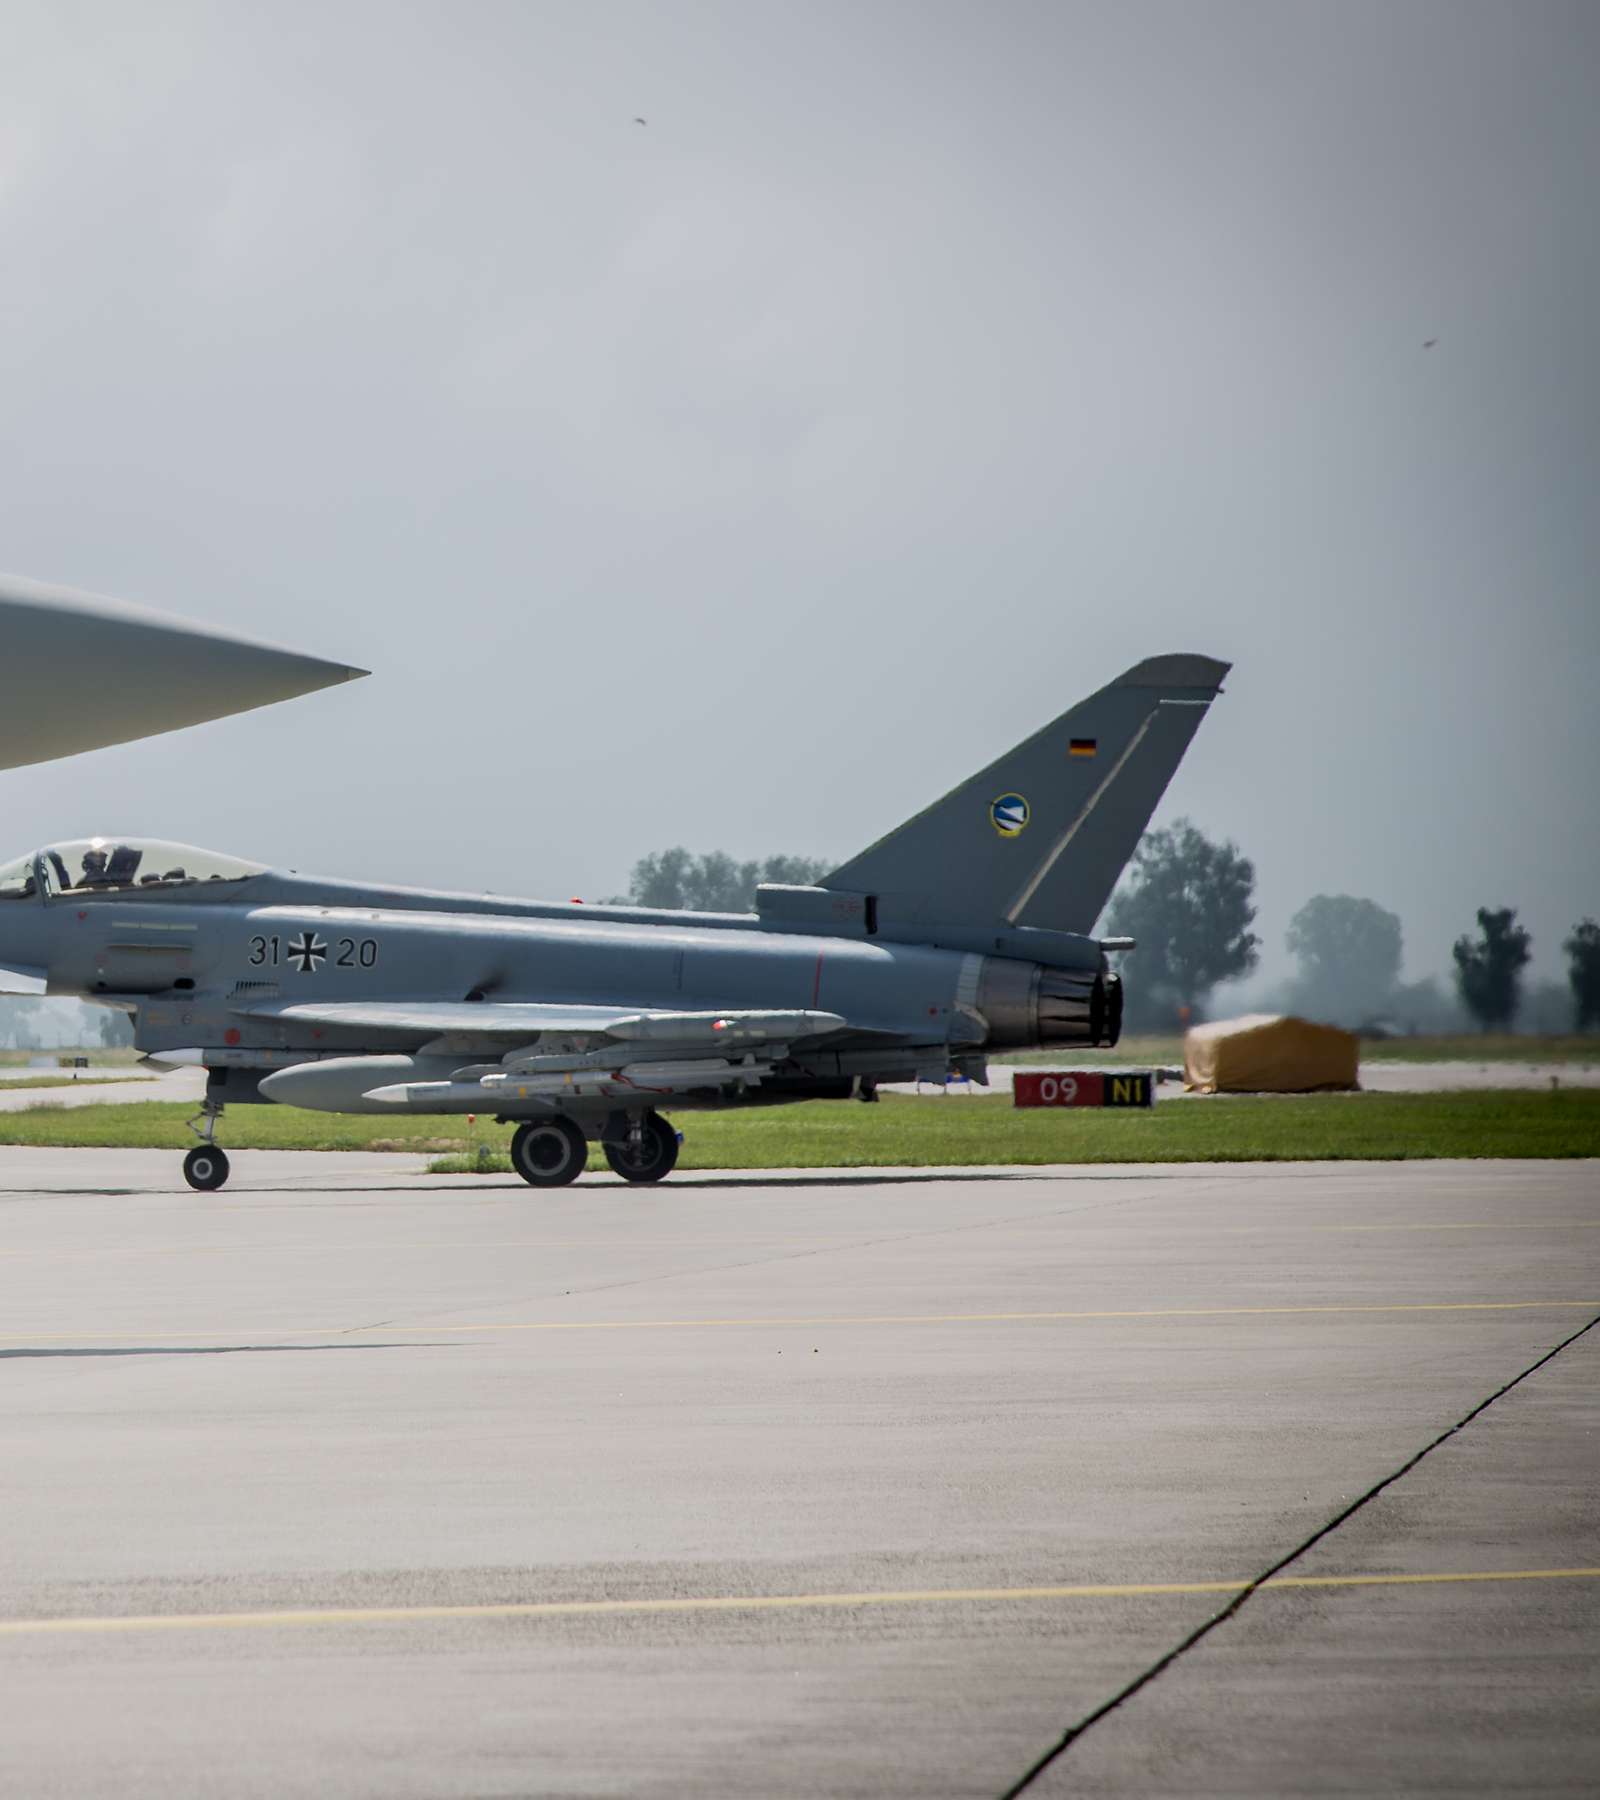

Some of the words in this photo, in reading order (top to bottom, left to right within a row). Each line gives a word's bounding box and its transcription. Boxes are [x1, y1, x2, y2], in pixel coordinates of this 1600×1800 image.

[248, 934, 280, 968] 31
[336, 937, 378, 968] 20
[1039, 1077, 1078, 1102] 09
